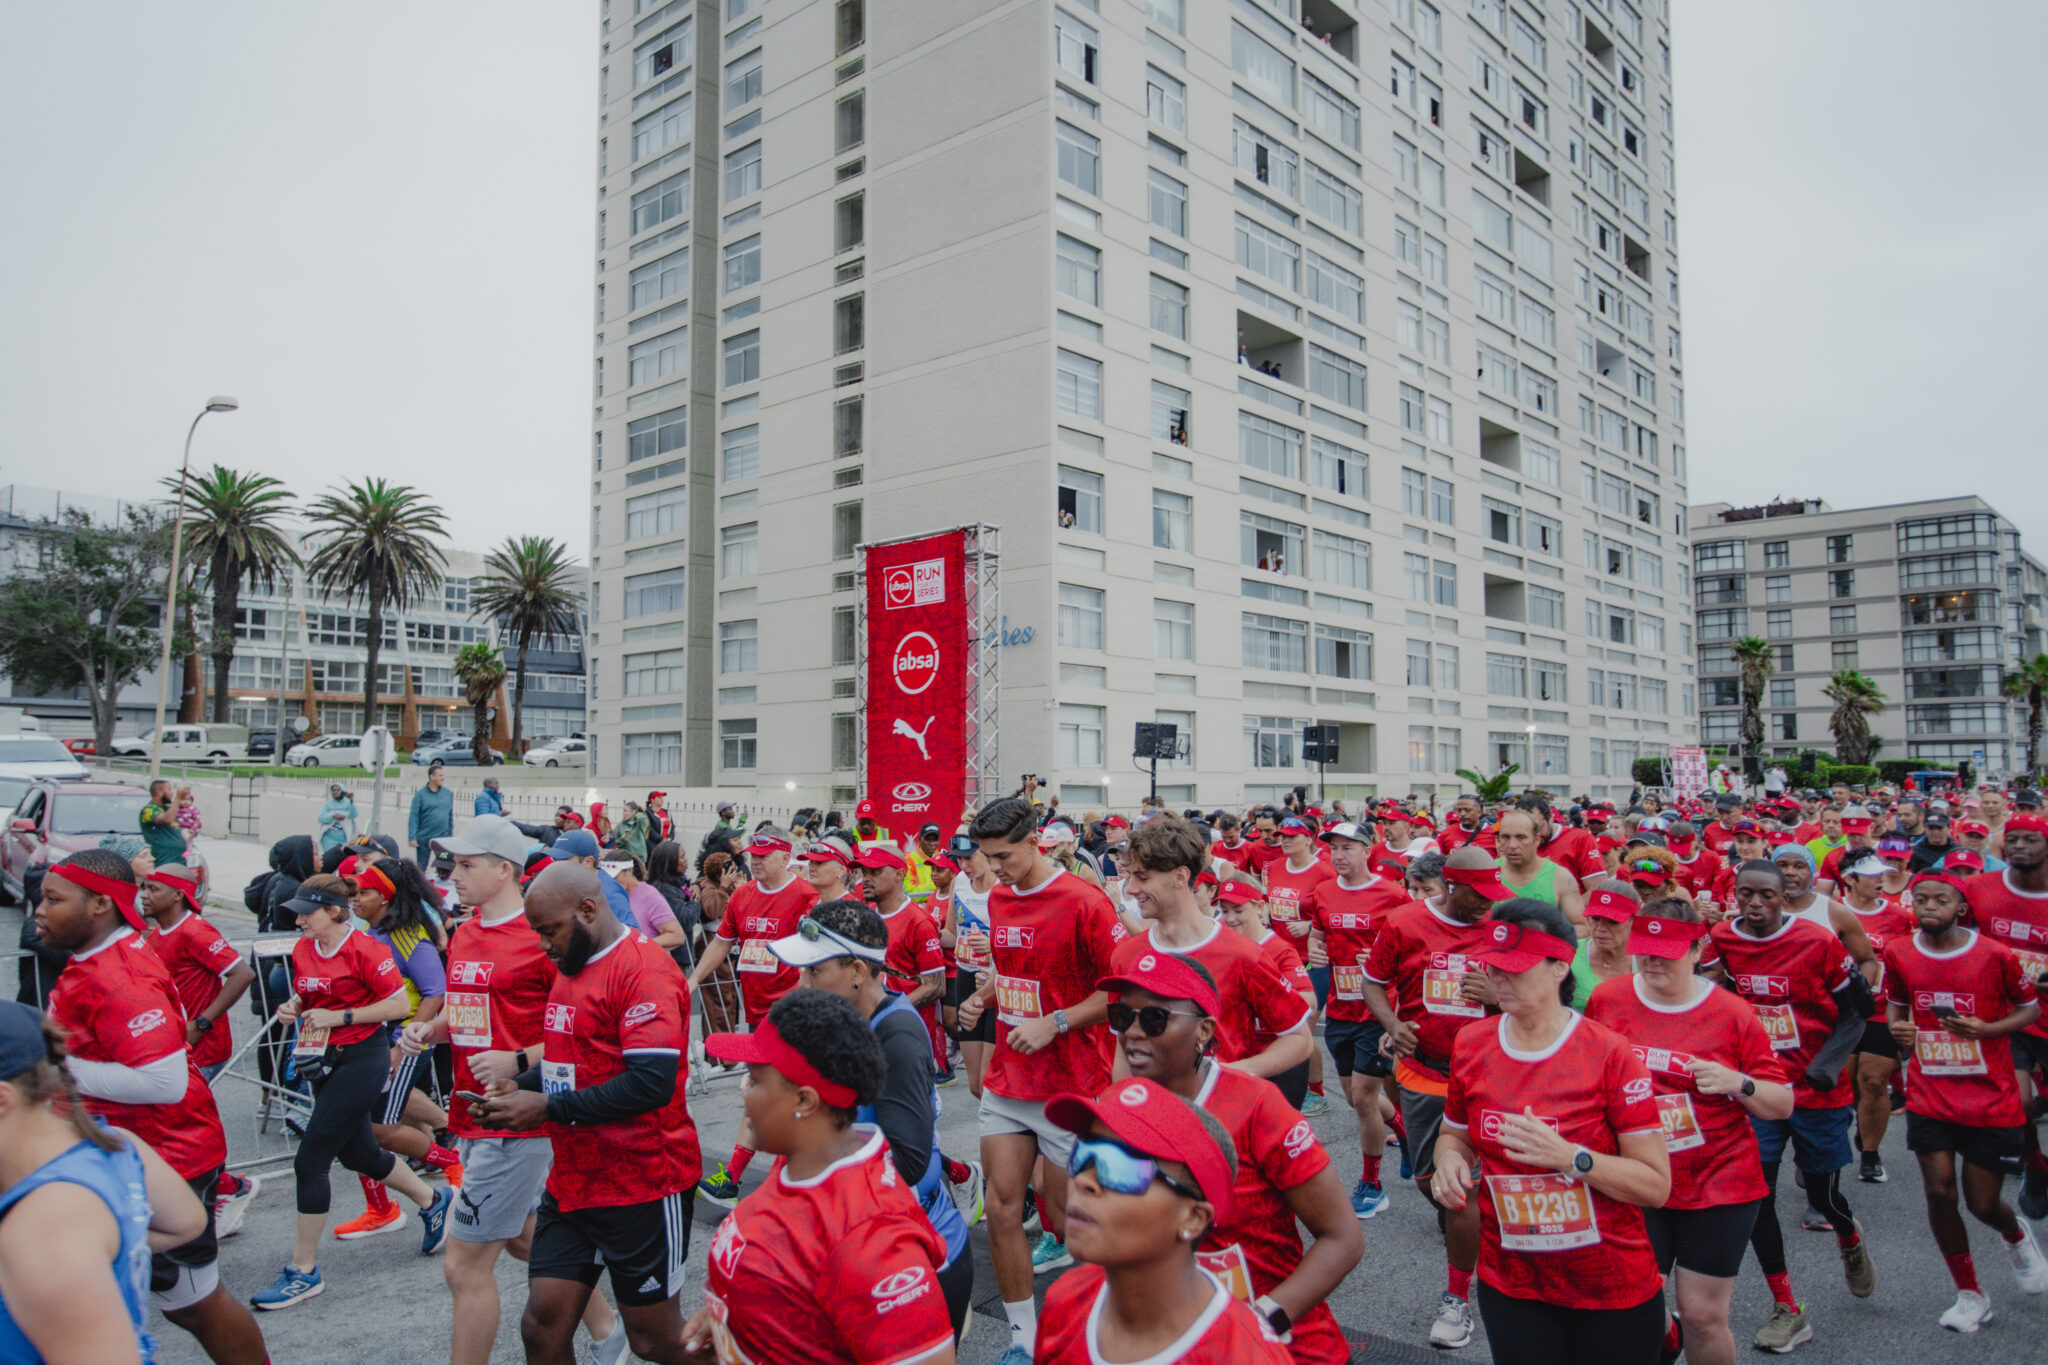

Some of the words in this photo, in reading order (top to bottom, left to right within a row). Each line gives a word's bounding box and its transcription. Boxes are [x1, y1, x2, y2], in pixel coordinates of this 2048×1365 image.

[916, 565, 941, 582] RUN
[898, 650, 934, 671] absa
[892, 803, 931, 813] CHERY
[1432, 980, 1441, 998] B
[999, 987, 1006, 1006] B
[1007, 989, 1033, 1011] 1816
[449, 1006, 457, 1026] B
[457, 1006, 485, 1028] 2658
[625, 1012, 657, 1027] CHERY
[1649, 1050, 1669, 1060] RUN
[1921, 1042, 1932, 1060] B
[1934, 1042, 1973, 1061] 2815
[1503, 1194, 1520, 1224] B
[1522, 1189, 1581, 1224] 1236
[1539, 1224, 1565, 1234] 2025
[876, 1281, 930, 1314] CHERY
